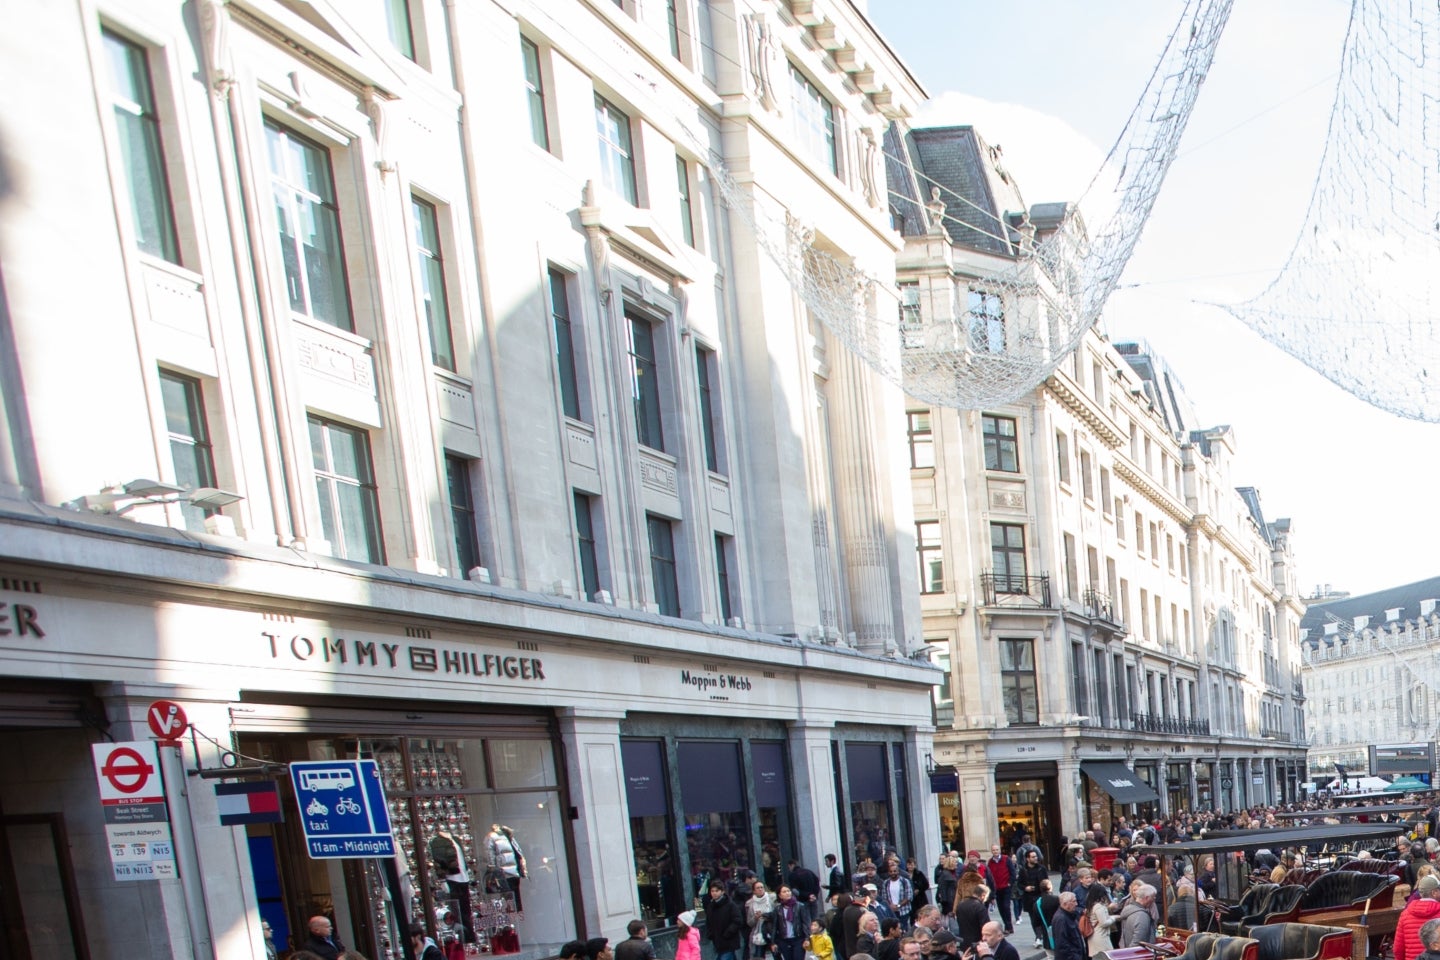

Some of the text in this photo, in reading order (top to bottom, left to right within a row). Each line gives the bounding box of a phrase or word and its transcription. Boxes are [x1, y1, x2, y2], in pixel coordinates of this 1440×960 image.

[261, 631, 546, 681] TOMMY HILFIGER
[681, 669, 752, 691] Mappin & Webb
[309, 820, 330, 831] taxi
[137, 829, 162, 837] Aldwych
[133, 847, 146, 856] 139
[344, 840, 391, 853] Midnight
